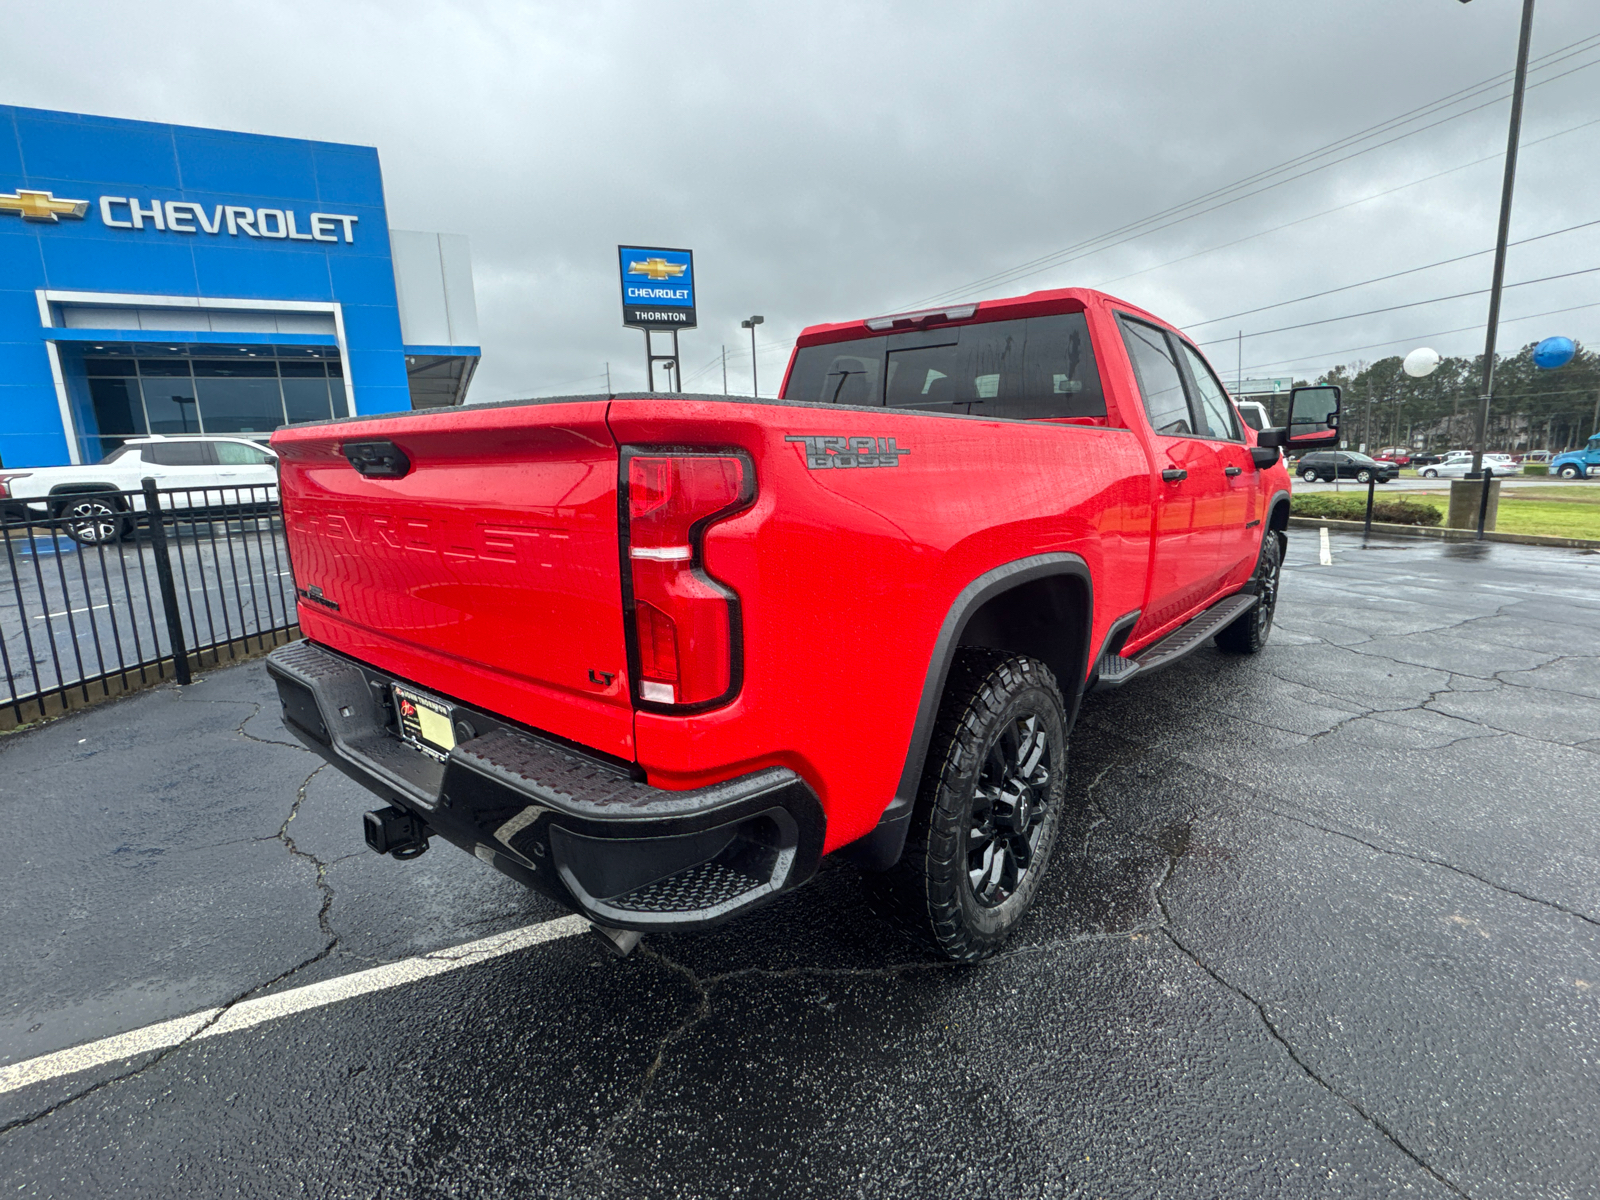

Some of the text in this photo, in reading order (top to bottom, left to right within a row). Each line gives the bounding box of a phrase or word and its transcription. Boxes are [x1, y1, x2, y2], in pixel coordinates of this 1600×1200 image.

[100, 195, 359, 244] CHEVROLET
[628, 287, 689, 299] CHEVROLET
[635, 311, 687, 321] THORNTON
[784, 435, 911, 455] TRAIL
[806, 454, 899, 470] BOSS
[588, 669, 615, 686] LT
